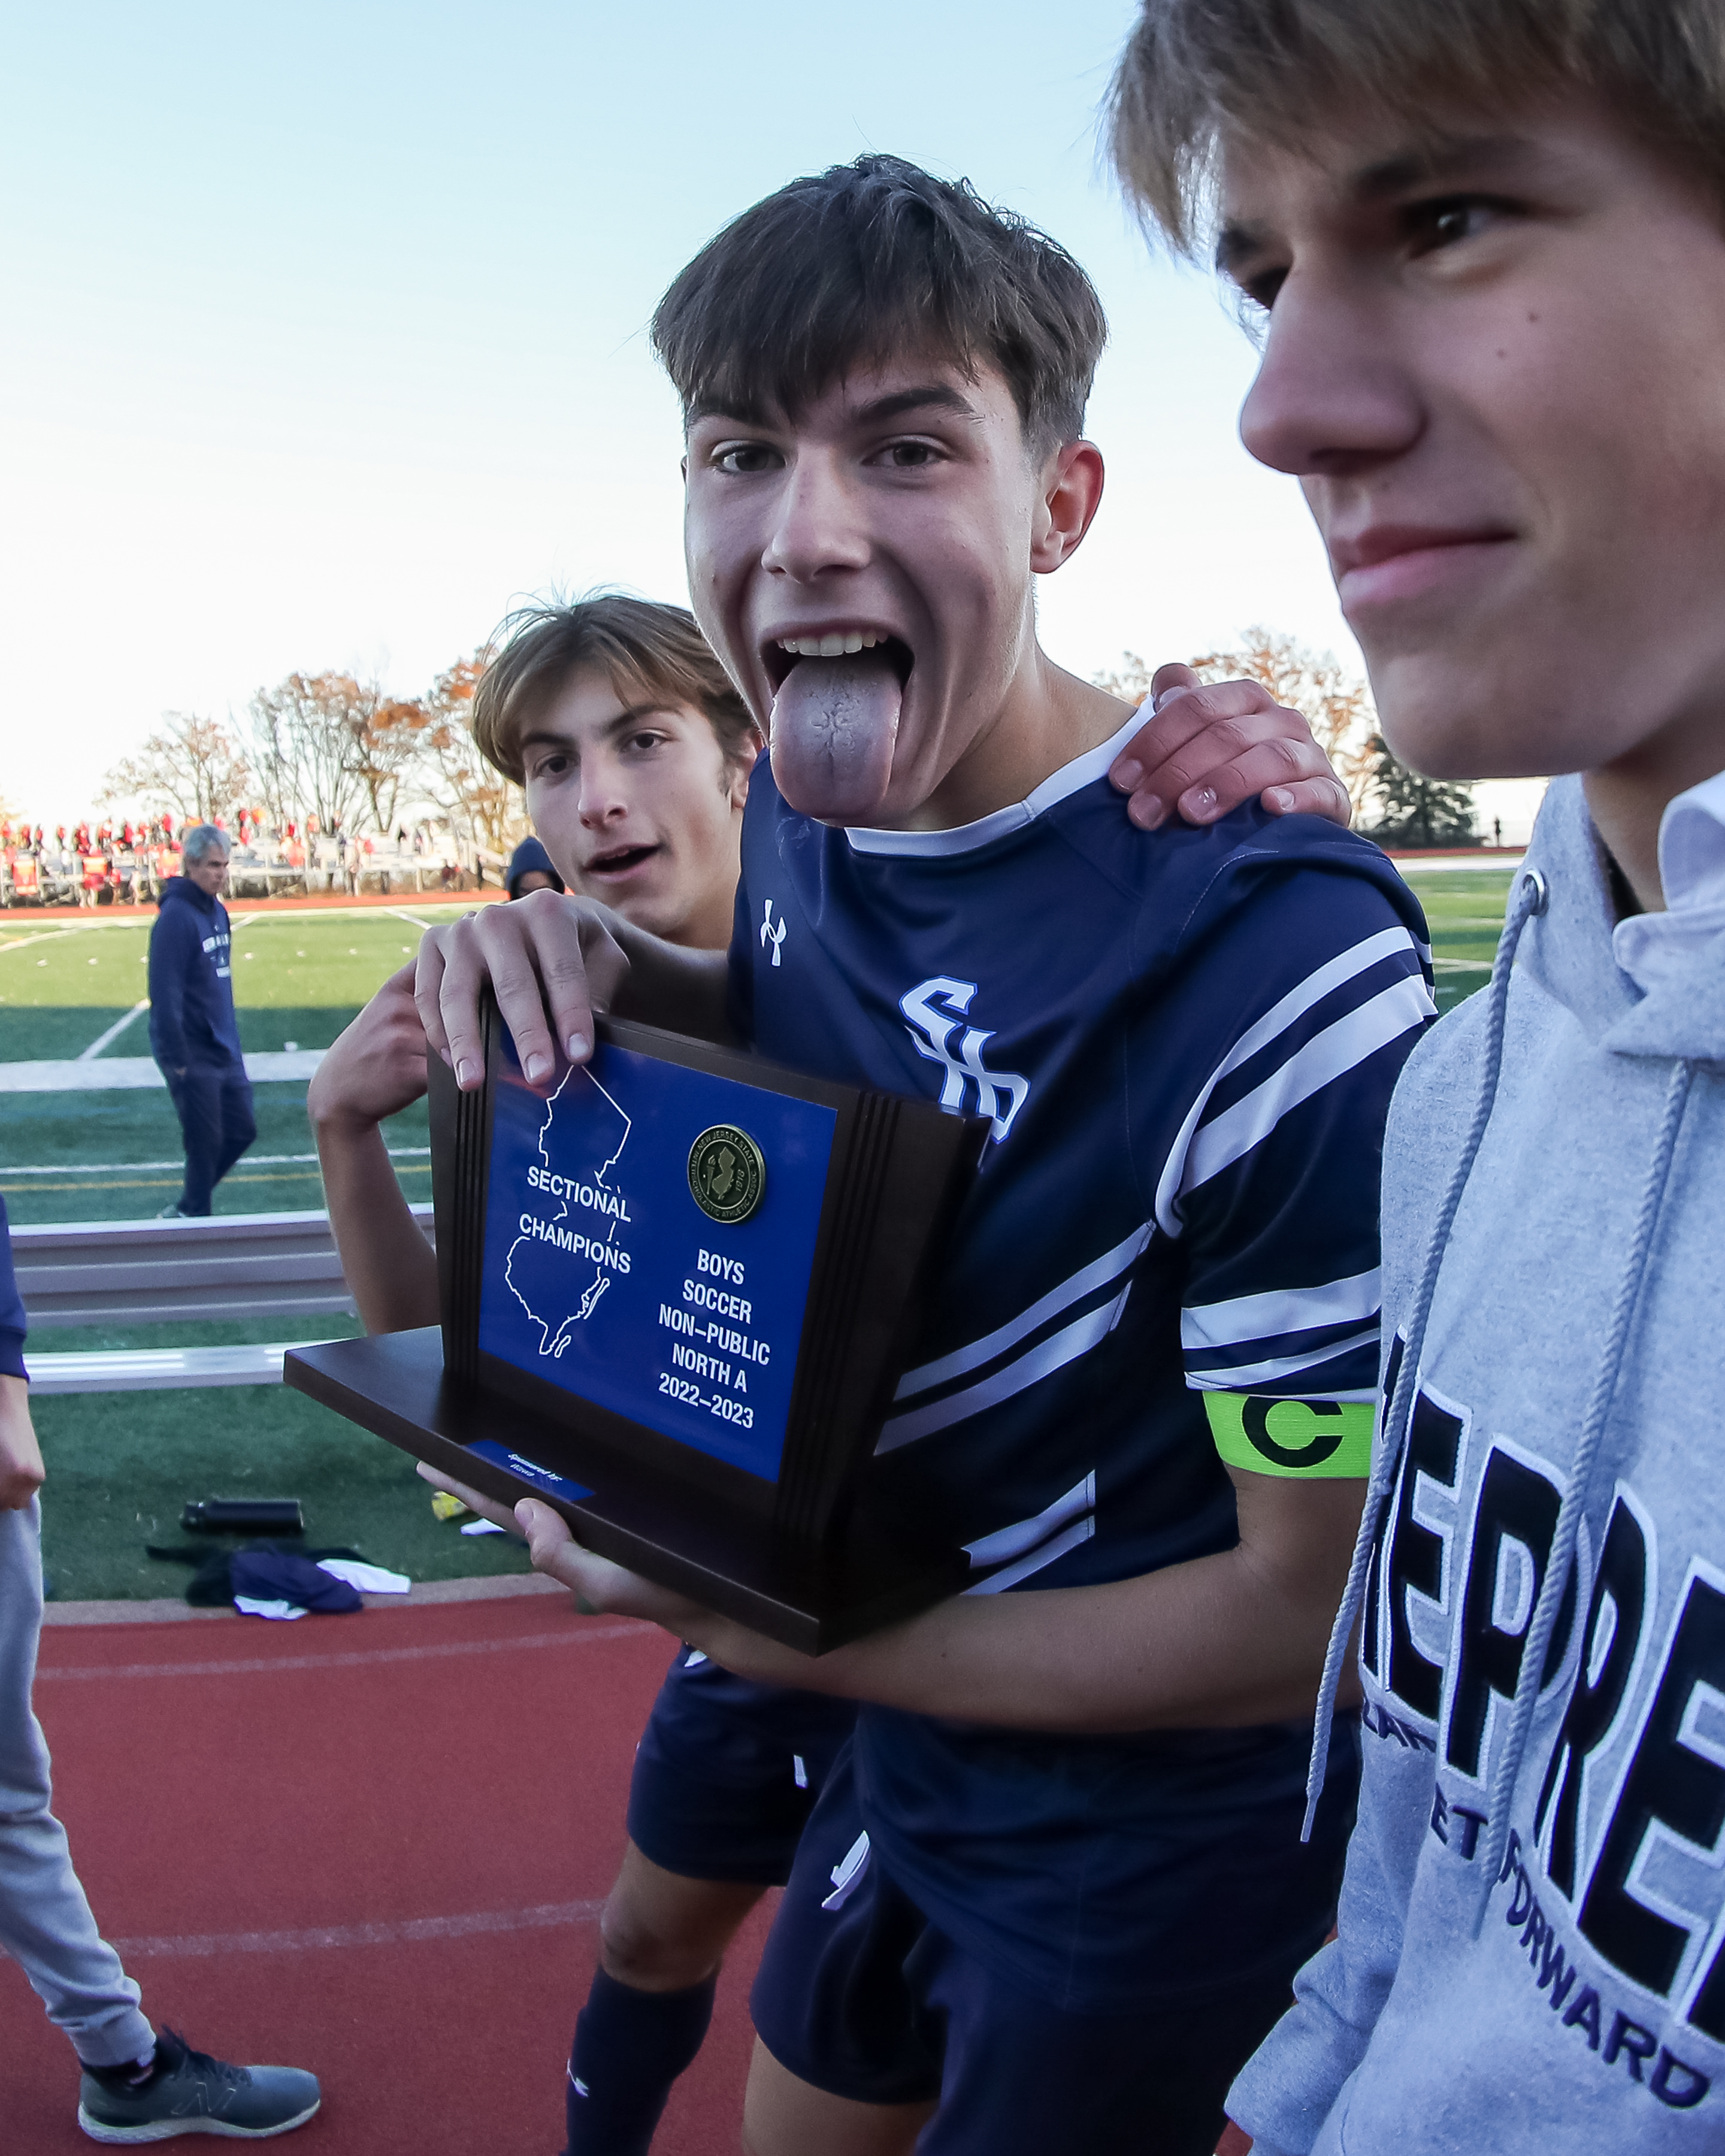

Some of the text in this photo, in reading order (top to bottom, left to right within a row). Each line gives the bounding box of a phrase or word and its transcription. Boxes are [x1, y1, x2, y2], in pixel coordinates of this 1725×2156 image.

[698, 1134, 711, 1149] NEW
[713, 1131, 739, 1143] JERSEY
[738, 1140, 755, 1165] STATE
[526, 1165, 632, 1222] SECTIONAL
[736, 1169, 745, 1192] 1918
[519, 1213, 632, 1274] CHAMPIONS
[697, 1248, 745, 1285] BOYS
[683, 1279, 752, 1324] SOCCER
[659, 1303, 771, 1365] NON-PUBLIC
[672, 1342, 748, 1393] NORTH A
[658, 1373, 754, 1429] 2022-2023
[1241, 1395, 1344, 1468] C
[1499, 1828, 1711, 2110] FORWARD
